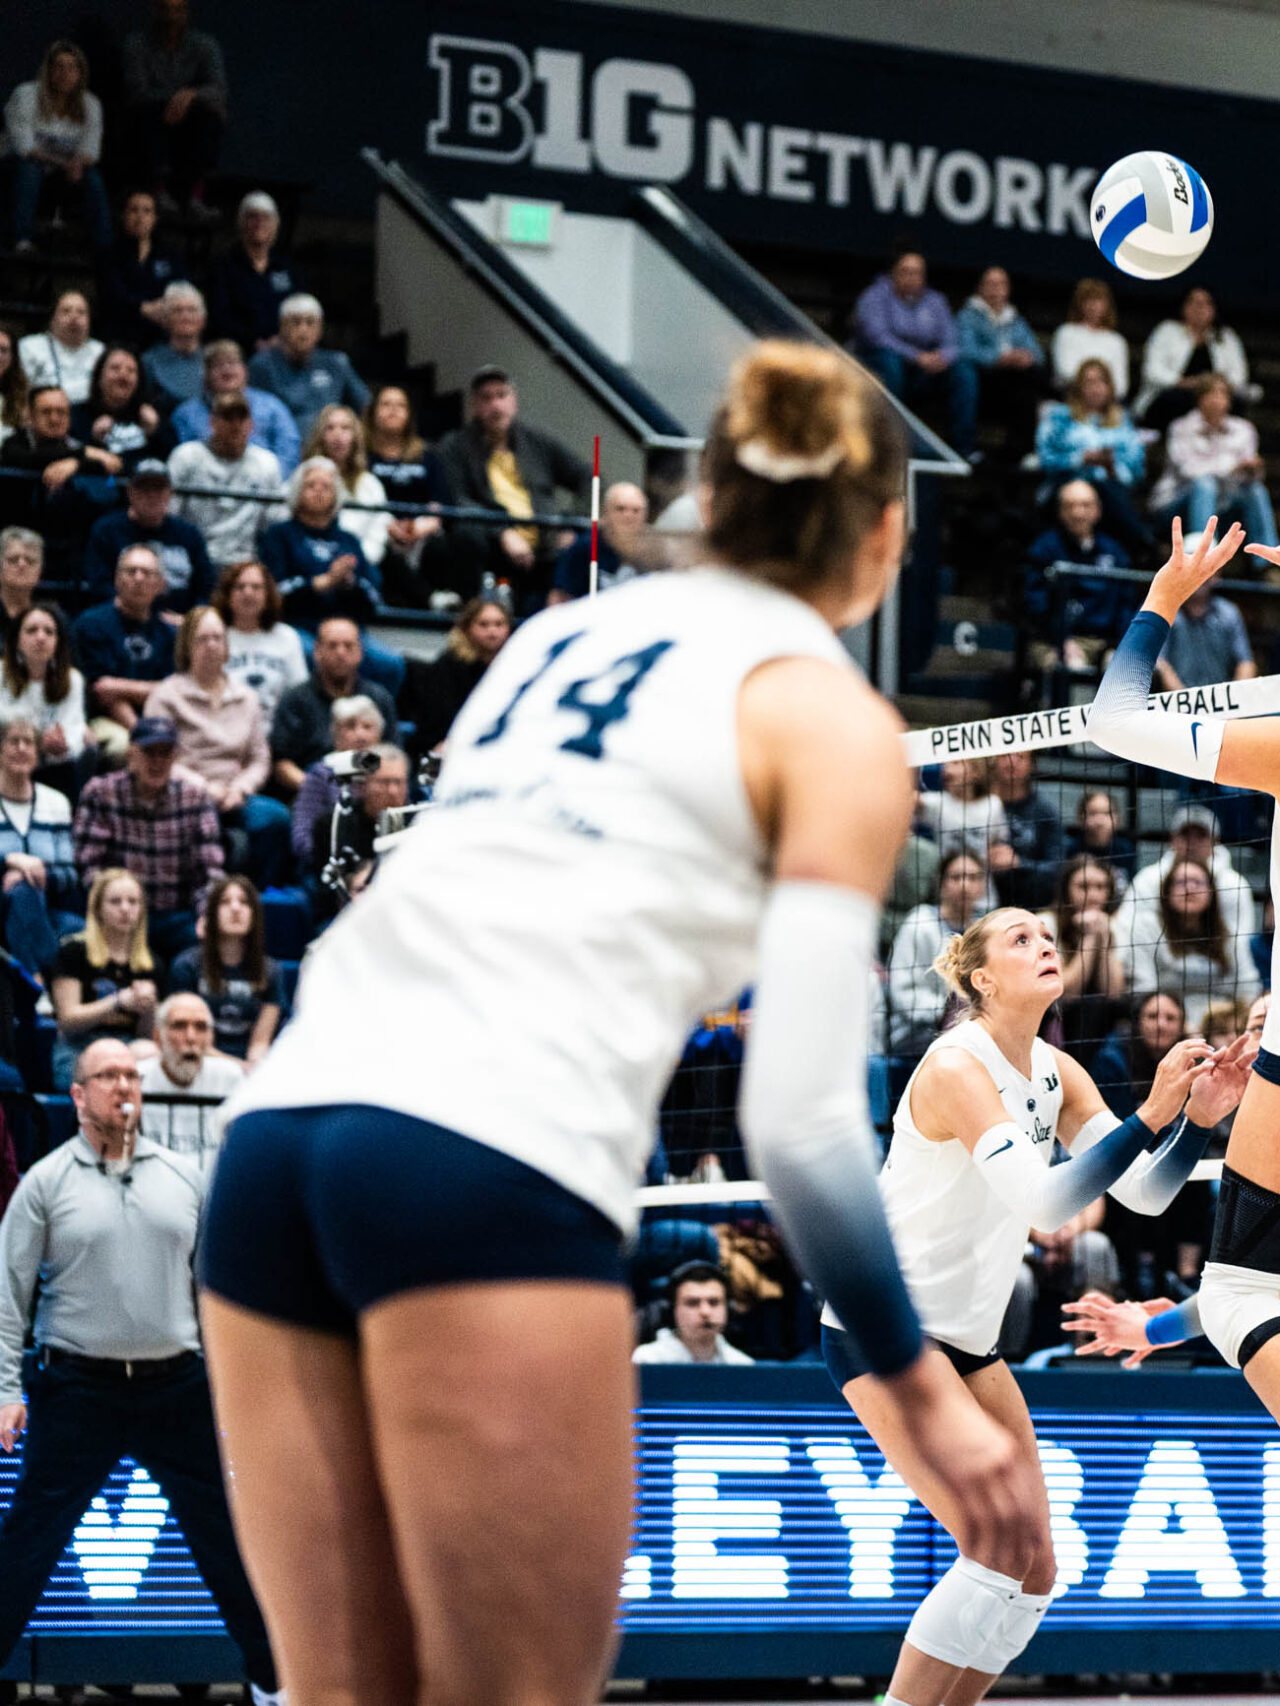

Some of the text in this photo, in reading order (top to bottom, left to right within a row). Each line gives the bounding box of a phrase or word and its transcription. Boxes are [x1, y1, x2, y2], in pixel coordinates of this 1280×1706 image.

[704, 115, 1099, 238] NETWORK
[474, 628, 676, 760] 14
[931, 721, 992, 755] PENN
[1001, 710, 1072, 746] STATE
